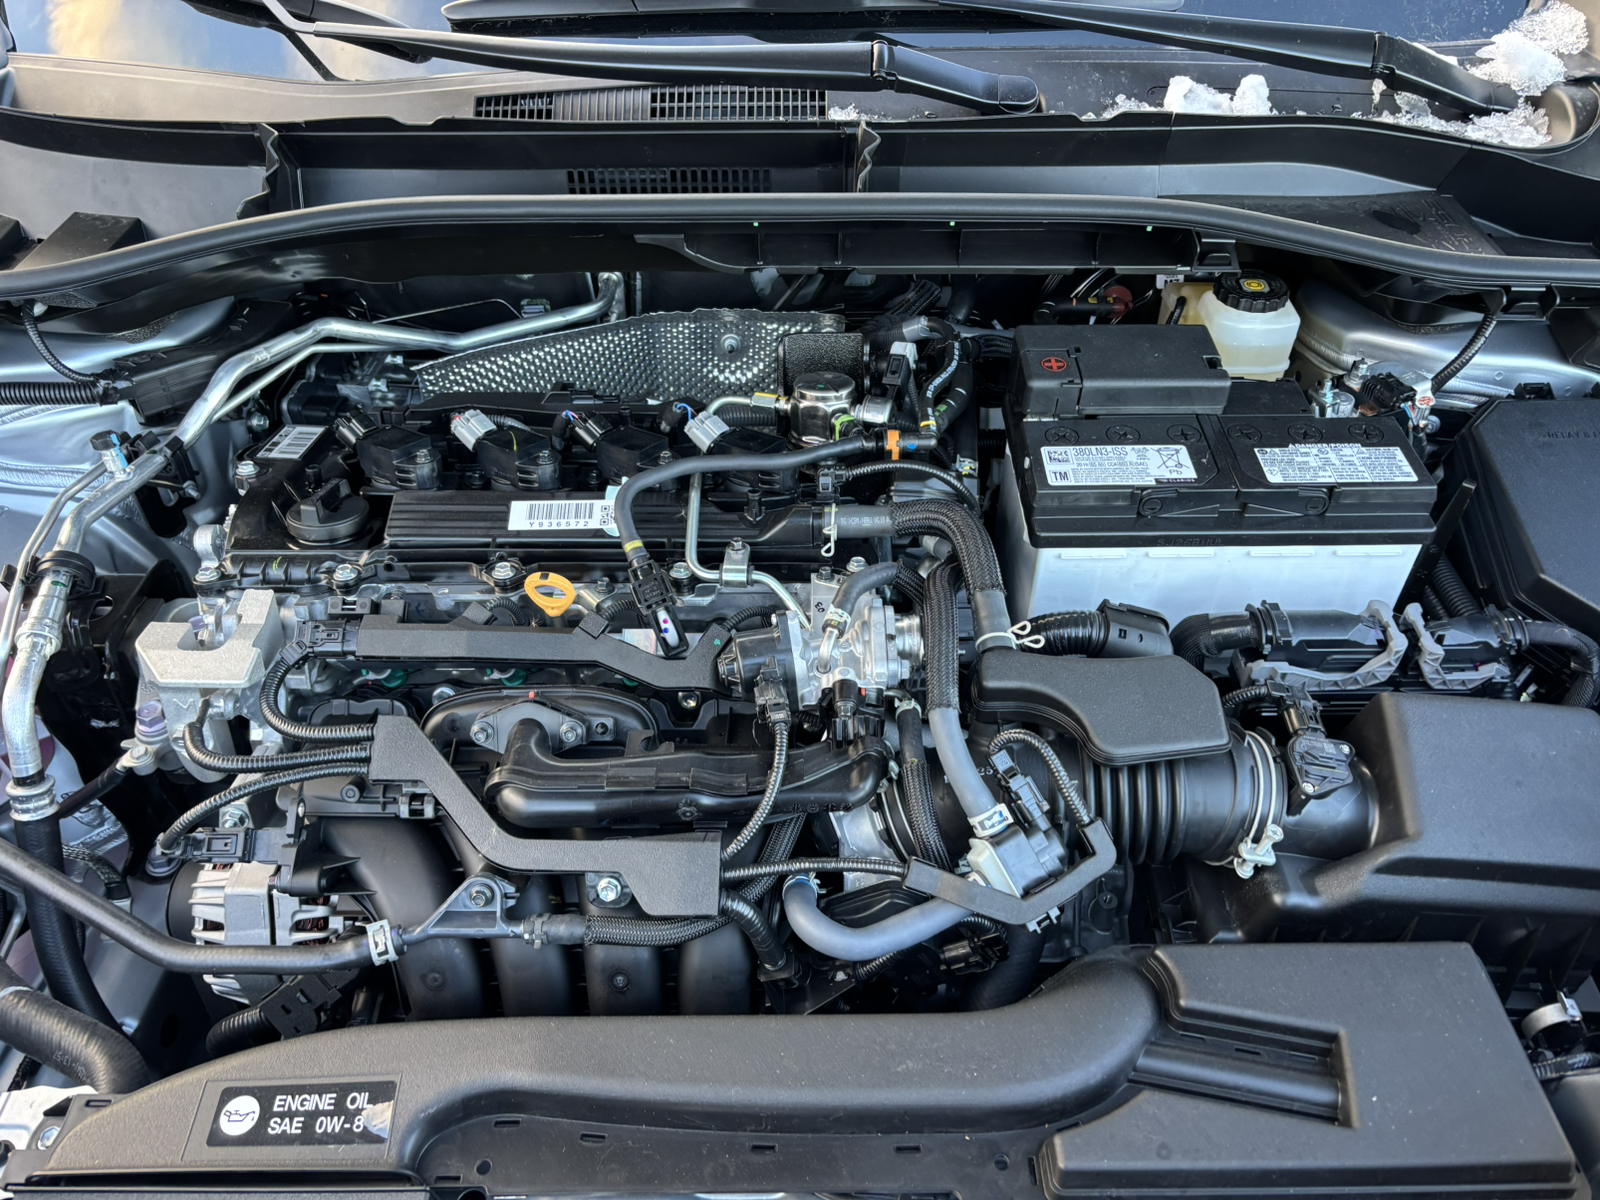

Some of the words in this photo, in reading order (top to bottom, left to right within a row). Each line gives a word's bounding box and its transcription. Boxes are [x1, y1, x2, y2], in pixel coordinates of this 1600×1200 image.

[1073, 447, 1128, 456] 380LN3-ISS
[1052, 472, 1069, 481] TM
[272, 1093, 337, 1112] ENGINE
[346, 1092, 373, 1109] OIL
[267, 1117, 304, 1134] SAE
[315, 1116, 364, 1133] 0W-8
